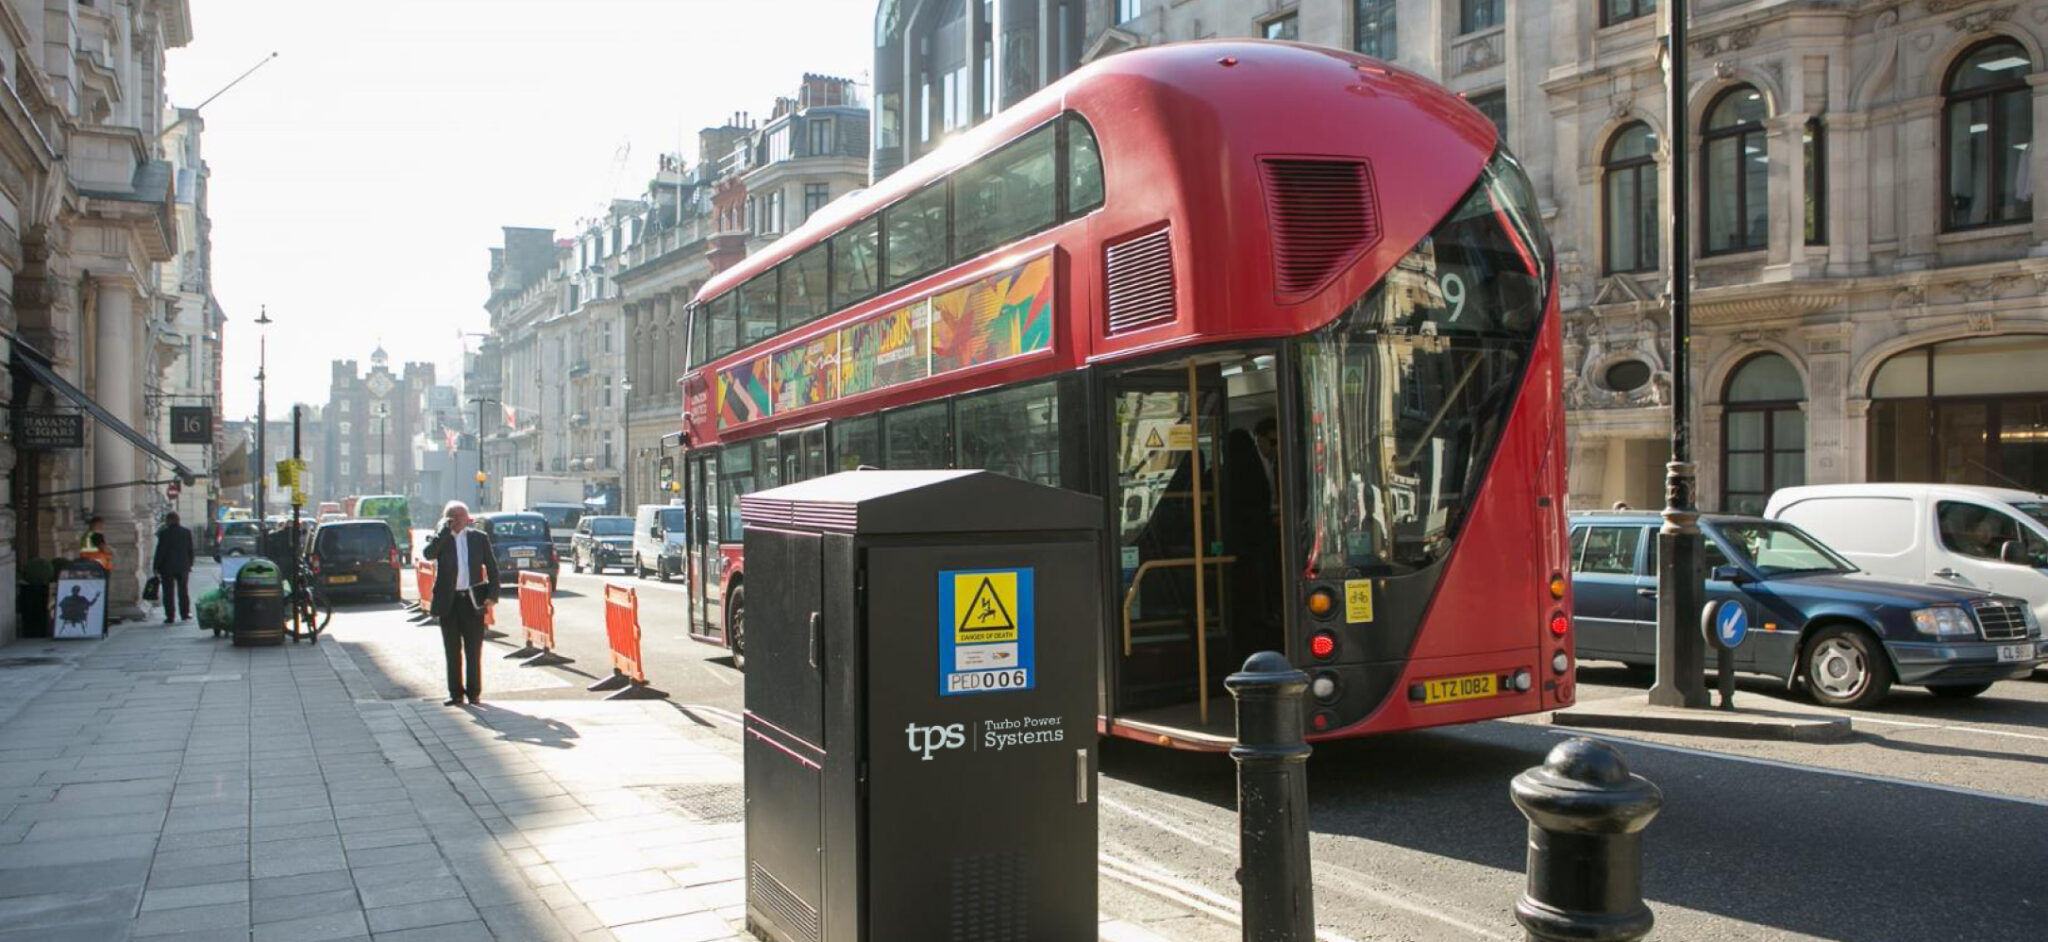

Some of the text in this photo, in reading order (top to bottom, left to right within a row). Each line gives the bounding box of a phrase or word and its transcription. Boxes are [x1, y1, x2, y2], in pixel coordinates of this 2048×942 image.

[1441, 272, 1466, 322] 9
[24, 417, 77, 427] HAVANA
[183, 415, 201, 432] 16
[25, 427, 75, 437] CIGARS
[961, 633, 985, 642] DANGER
[994, 632, 1014, 640] DEATH
[1432, 677, 1489, 699] LTZ 1082
[985, 716, 1062, 731] Turbo Power
[905, 722, 965, 760] tps
[985, 729, 1064, 750] Systems
